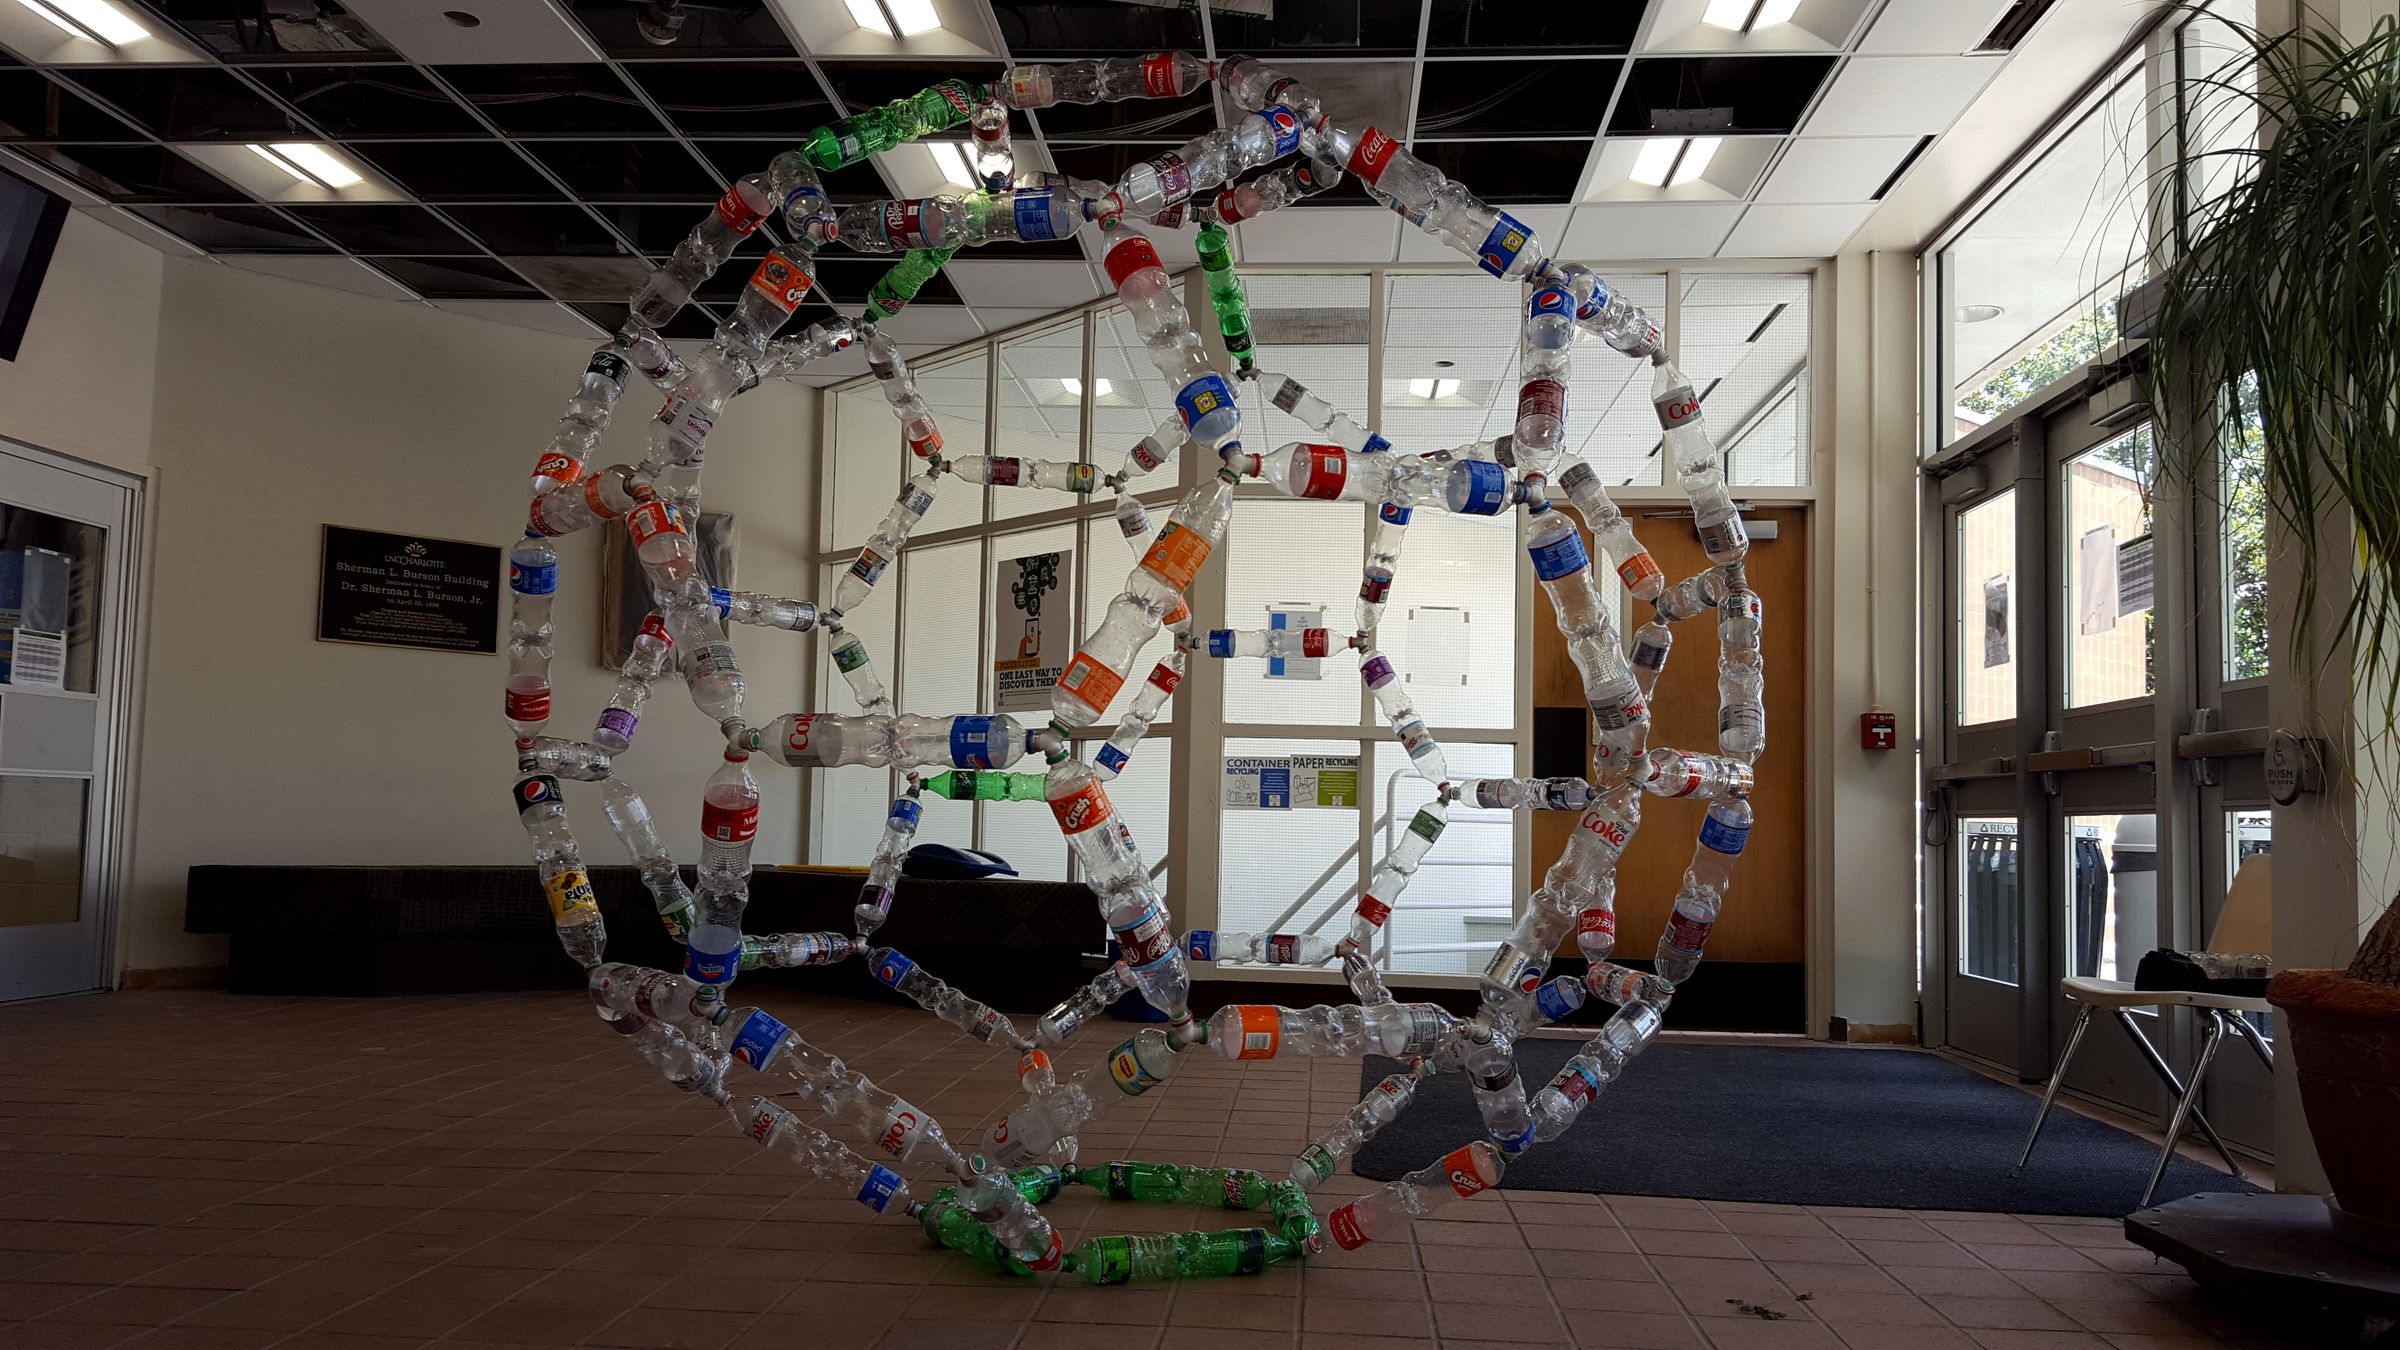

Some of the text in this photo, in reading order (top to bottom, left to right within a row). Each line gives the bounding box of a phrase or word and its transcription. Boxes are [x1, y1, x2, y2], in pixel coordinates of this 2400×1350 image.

[786, 288, 808, 302] Cru
[1136, 444, 1157, 469] Coke
[336, 562, 490, 589] Sherman L. Burson Building
[341, 581, 357, 591] Dr.
[361, 584, 410, 597] Sherman
[413, 590, 423, 598] L.
[470, 595, 483, 605] Jr.
[999, 667, 1062, 681] ONE EASY WAY TO
[999, 678, 1034, 690] DISCOVER
[1626, 701, 1646, 718] oke
[790, 712, 817, 751] Cok
[1226, 758, 1291, 768] CONTAINER
[1226, 767, 1259, 776] RECYCLING
[1293, 757, 1358, 769] PAPER RECYCLING
[2267, 769, 2294, 779] PUSH
[1065, 797, 1092, 829] Crush
[1583, 811, 1625, 847] Coke
[1615, 822, 1629, 835] Diet
[1990, 824, 2018, 833] RECY
[1507, 957, 1525, 984] pepsi
[742, 1037, 763, 1052] pepsi
[753, 1113, 774, 1141] oke
[881, 1112, 916, 1154] Coke
[1451, 1169, 1483, 1190] Crush
